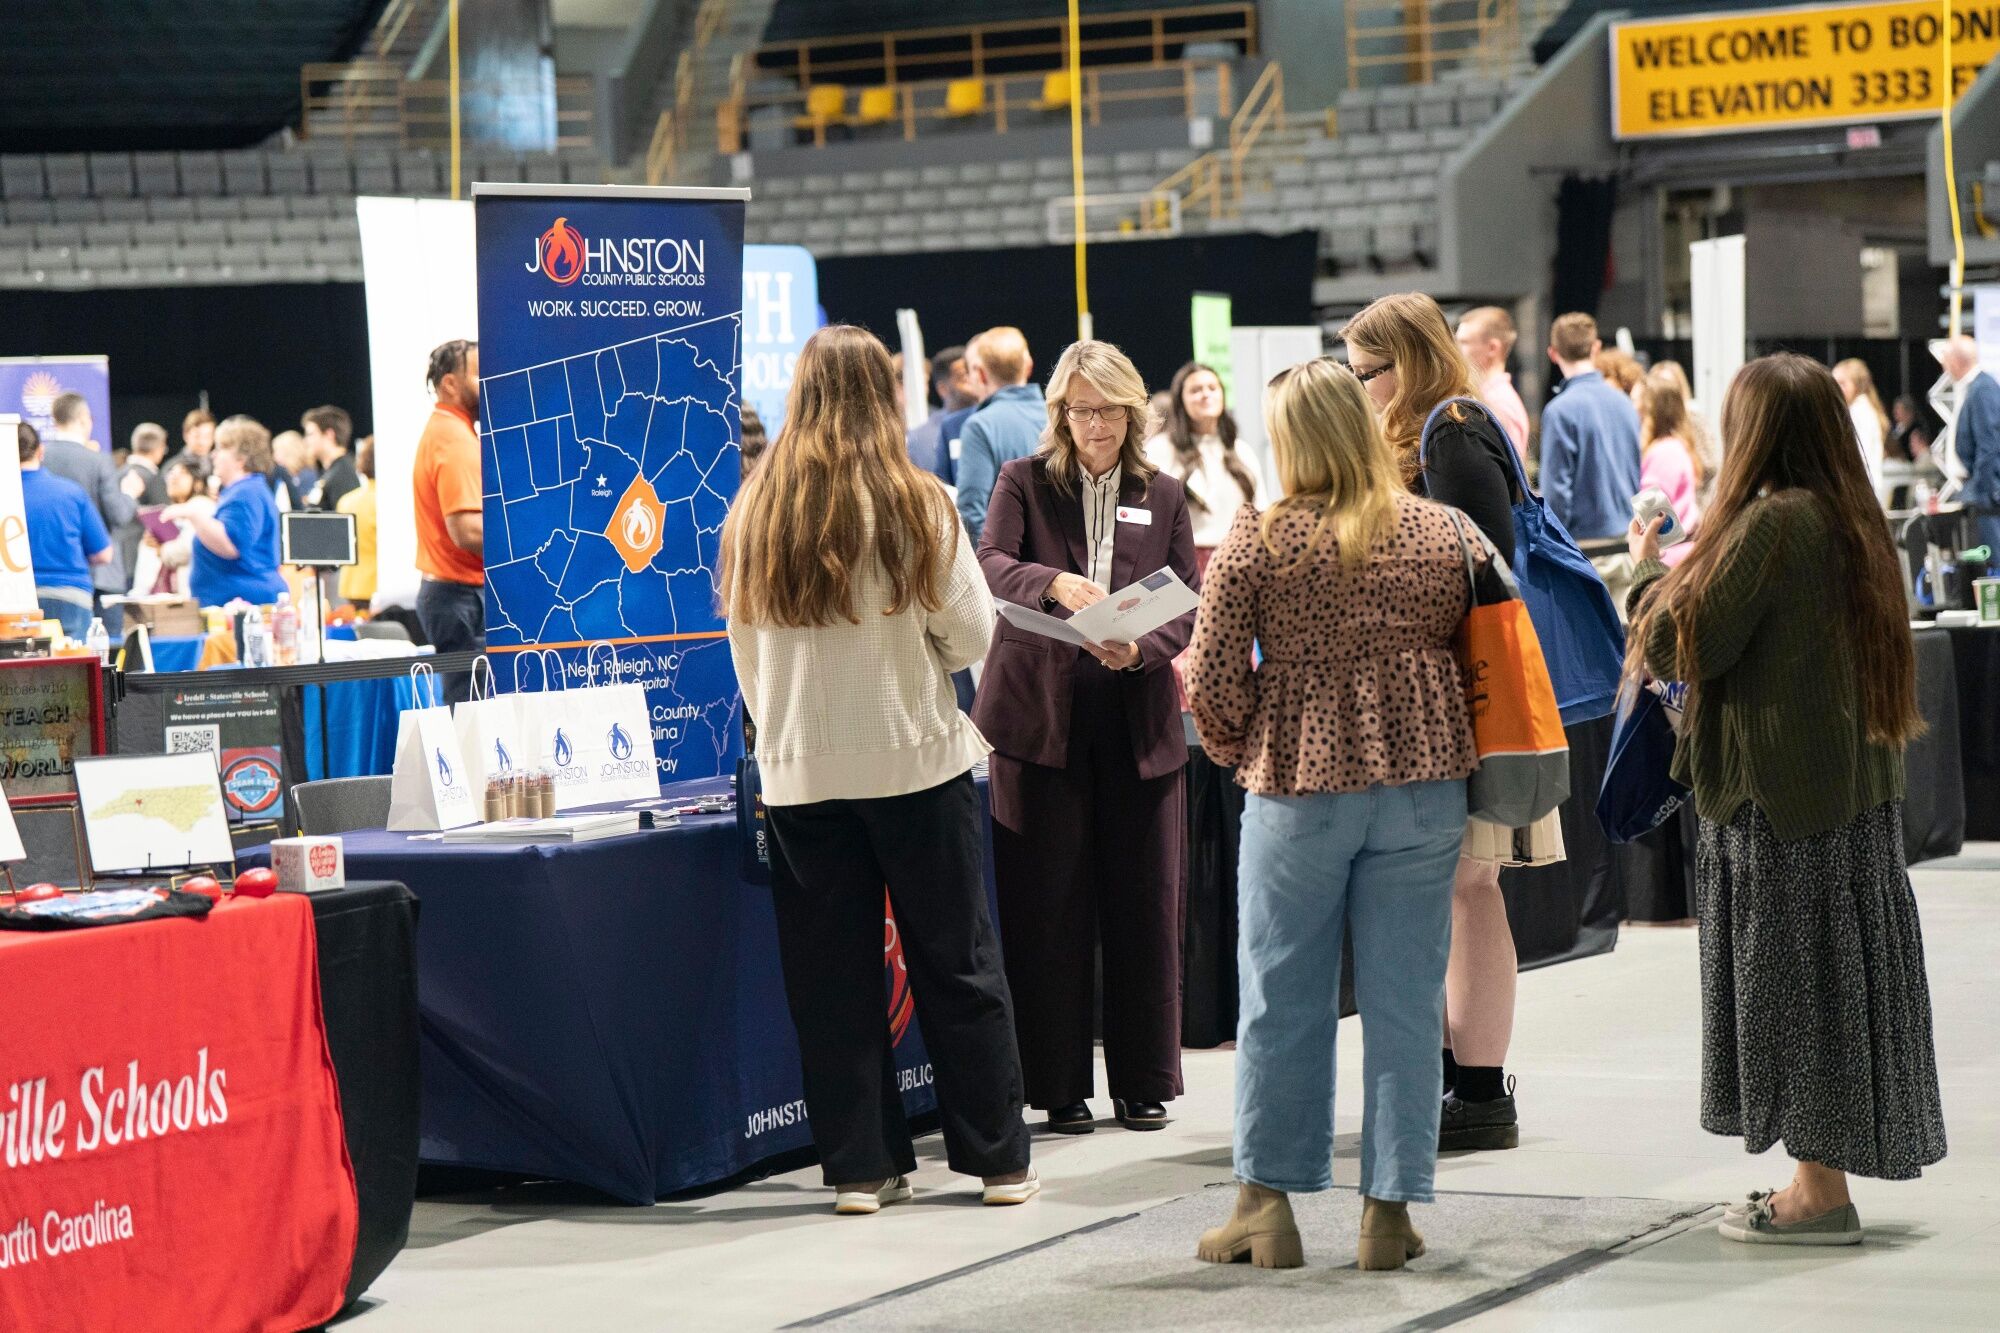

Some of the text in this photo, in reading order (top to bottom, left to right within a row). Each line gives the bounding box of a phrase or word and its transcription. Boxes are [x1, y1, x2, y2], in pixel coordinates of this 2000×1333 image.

[1631, 6, 2000, 72] WELCOME TO BOON
[1648, 77, 1833, 122] ELEVATION
[1850, 66, 1932, 107] 3333
[525, 226, 705, 284] JOHNSTON
[582, 273, 705, 286] COUNTY PUBLIC SCHOOLS
[528, 300, 705, 317] WORK. SUCCEED. GROW.
[658, 654, 678, 671] NC
[0, 705, 70, 726] TEACH
[653, 702, 700, 721] County
[0, 758, 74, 779] WORLD
[77, 1047, 228, 1152] Schools
[744, 1099, 808, 1139] JOHNST
[43, 1200, 134, 1257] Carolina
